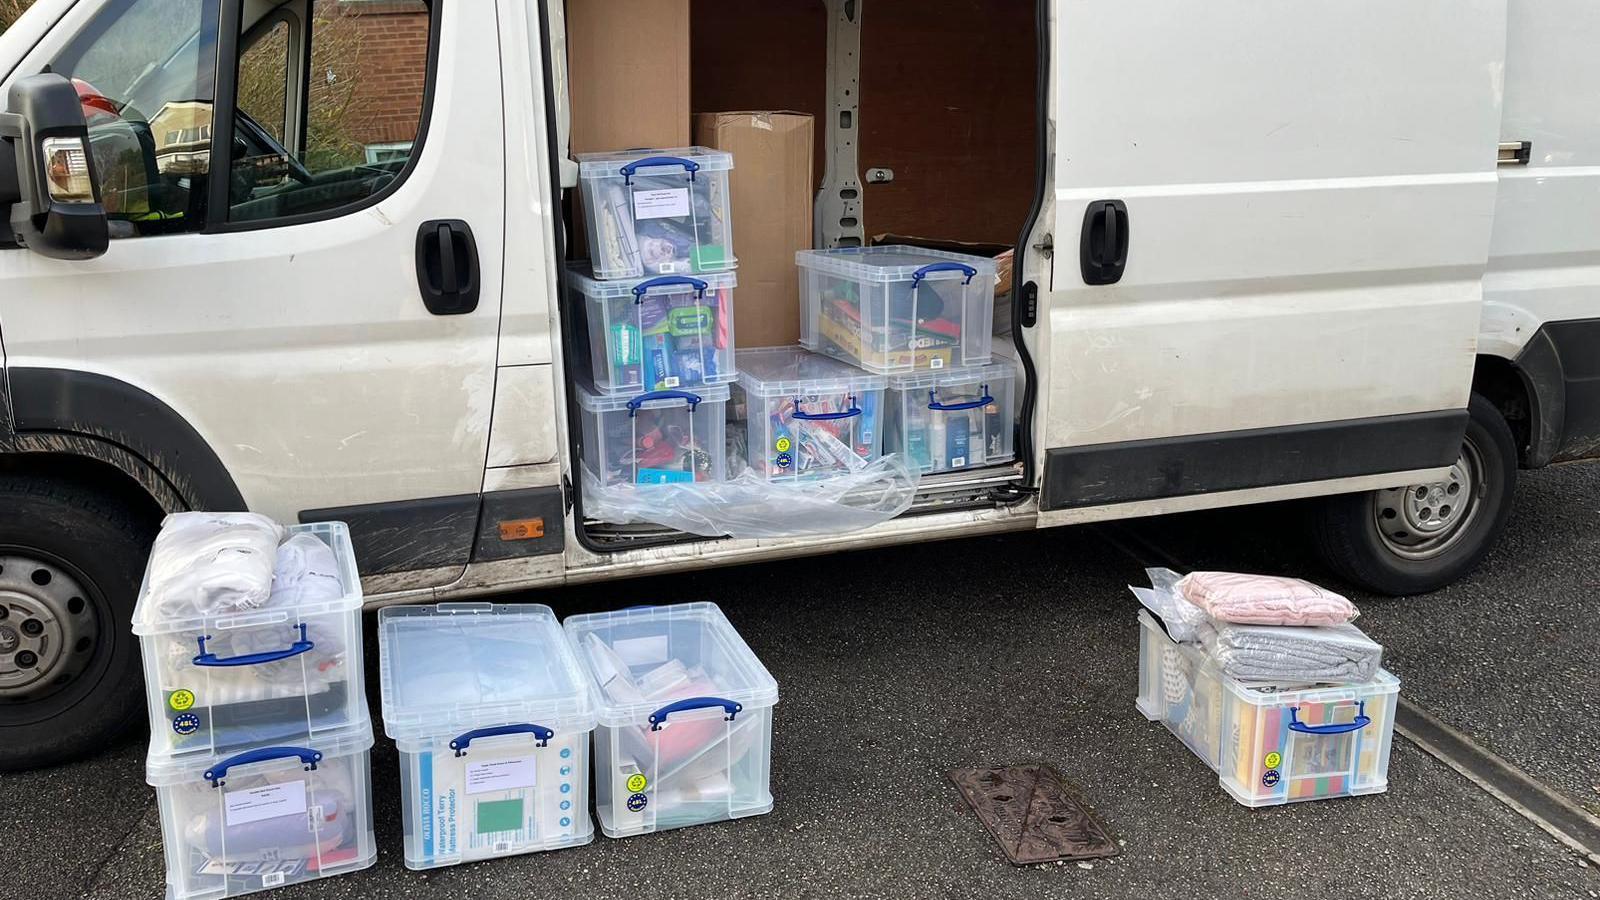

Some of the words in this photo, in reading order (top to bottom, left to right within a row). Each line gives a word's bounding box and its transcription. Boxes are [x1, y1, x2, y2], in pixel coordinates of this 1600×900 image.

[422, 789, 431, 814] ROCCO
[437, 795, 446, 815] Terry
[448, 788, 456, 822] Protector
